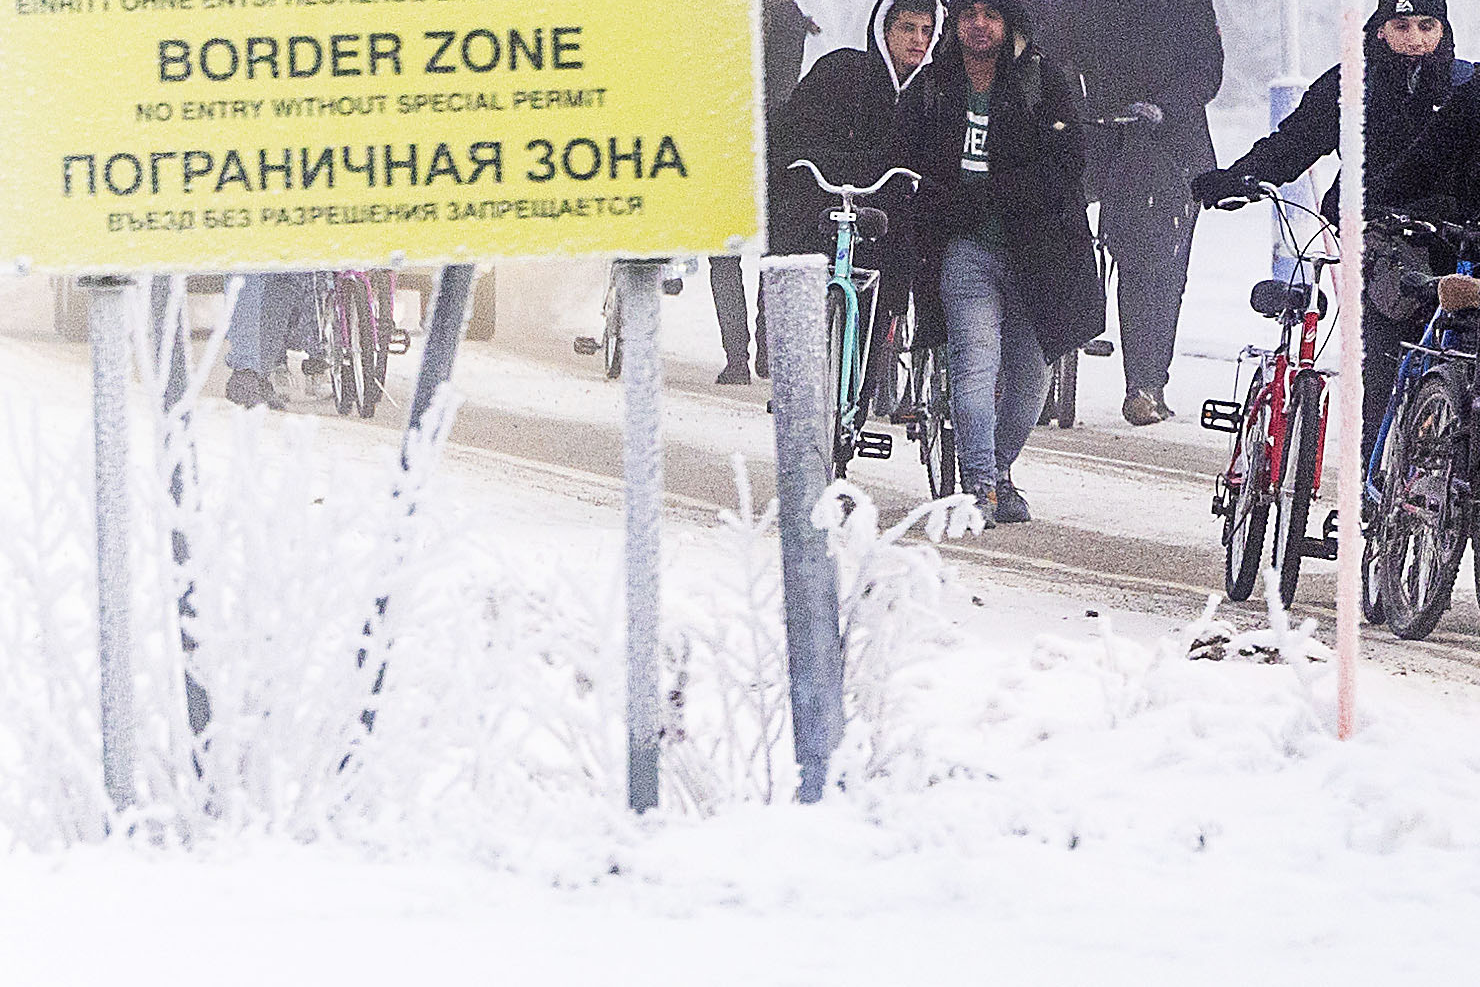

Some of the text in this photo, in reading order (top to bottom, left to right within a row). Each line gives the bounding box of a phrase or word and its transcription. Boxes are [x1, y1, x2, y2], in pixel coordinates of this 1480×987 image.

[158, 27, 585, 82] BORDER ZONE
[135, 89, 607, 122] NO ENTRY WITHOUT SPECIAL PERMIT
[63, 135, 689, 197] ПОГРАНИЧНАЯ ЗОНА
[202, 208, 251, 228] БЕЗ
[259, 202, 438, 227] РАЗРЕШЕНИЯ
[446, 196, 643, 223] ЗАПРЕЩАЕТСЯ
